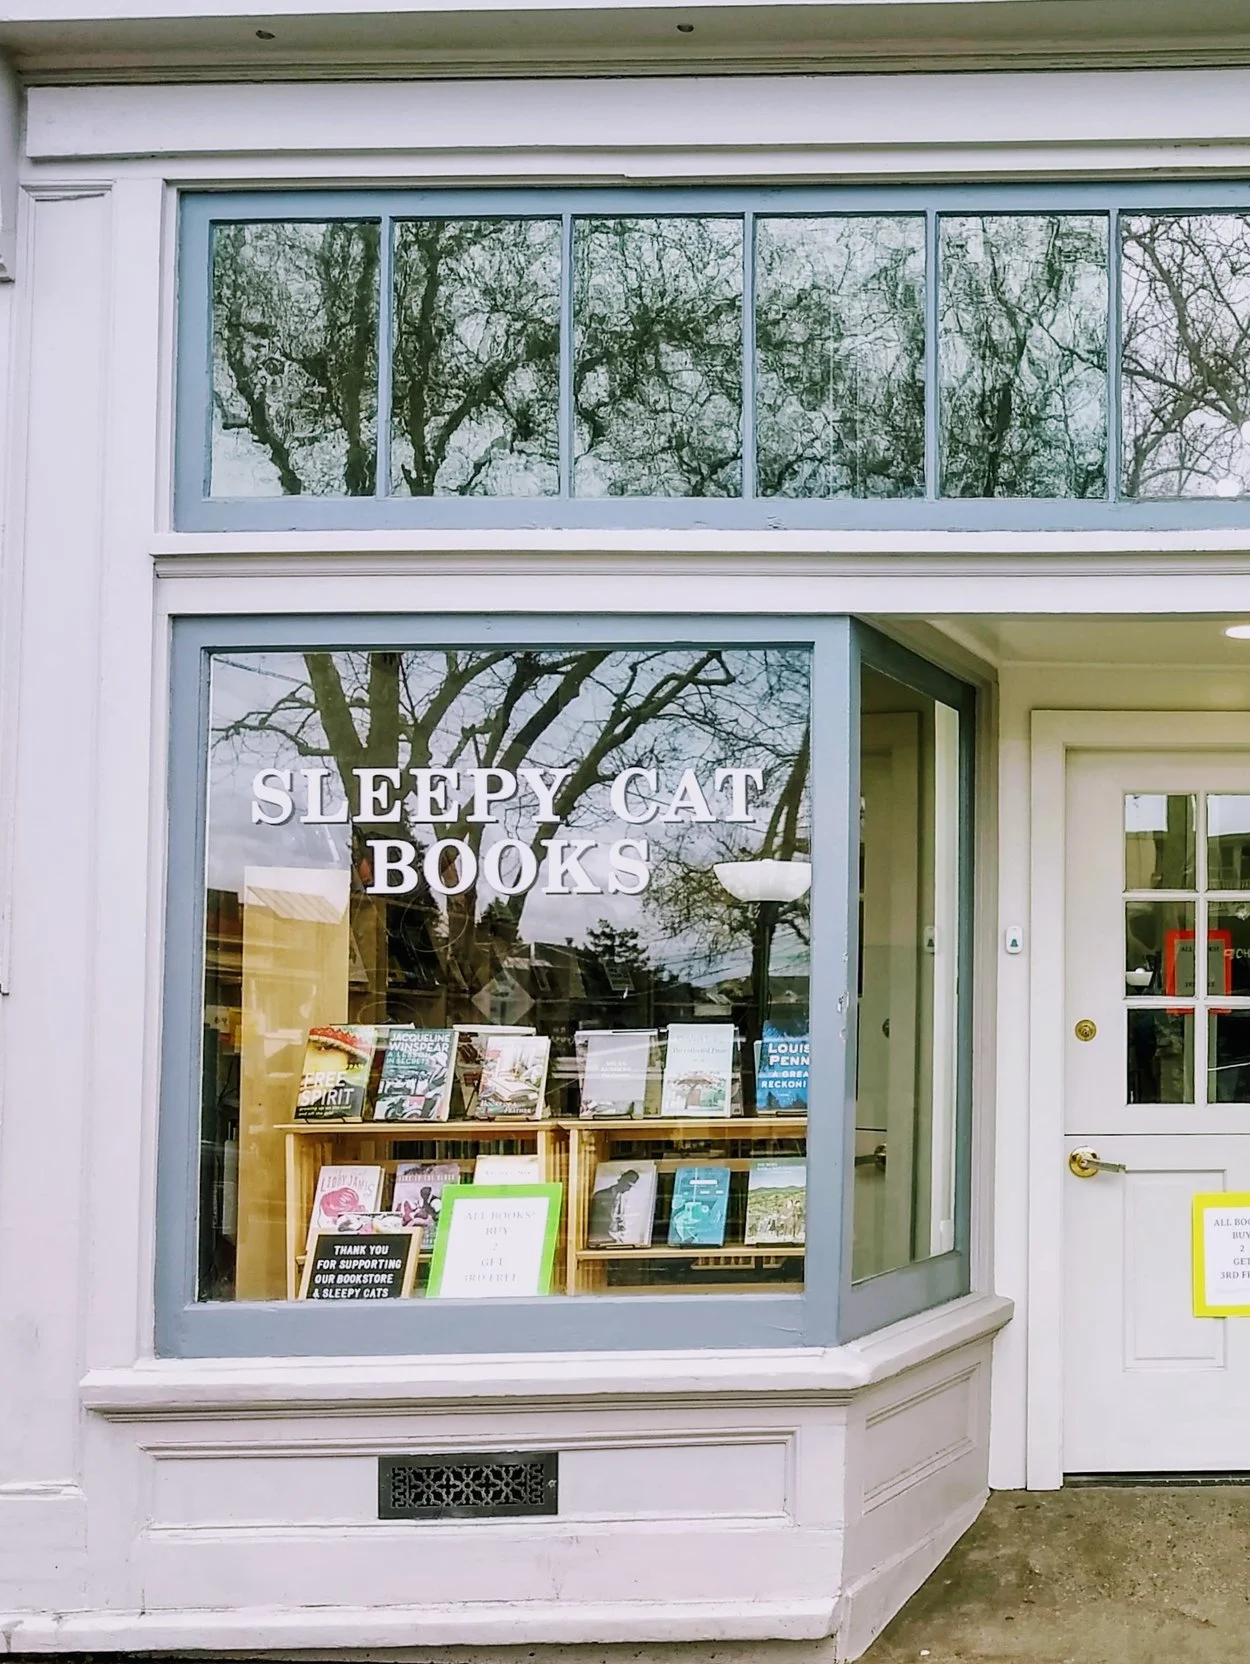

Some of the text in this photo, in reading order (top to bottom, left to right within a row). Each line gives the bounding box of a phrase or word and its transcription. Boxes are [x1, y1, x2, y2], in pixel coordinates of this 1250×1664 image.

[251, 767, 765, 824] SLEEPY CAT
[366, 838, 651, 896] BOOKS
[390, 1033, 450, 1042] JACQUELINE
[389, 1041, 450, 1051] WINSPEAR
[302, 1071, 347, 1088] FREE
[299, 1088, 354, 1106] SPIRIT
[334, 1245, 389, 1256] THANK YOU
[317, 1259, 402, 1270] FOR SUPPORTING
[315, 1274, 394, 1284] OUR BOOKSTORE
[1220, 1271, 1239, 1279] 3RD
[313, 1288, 389, 1298] & SLEEPY CATS
